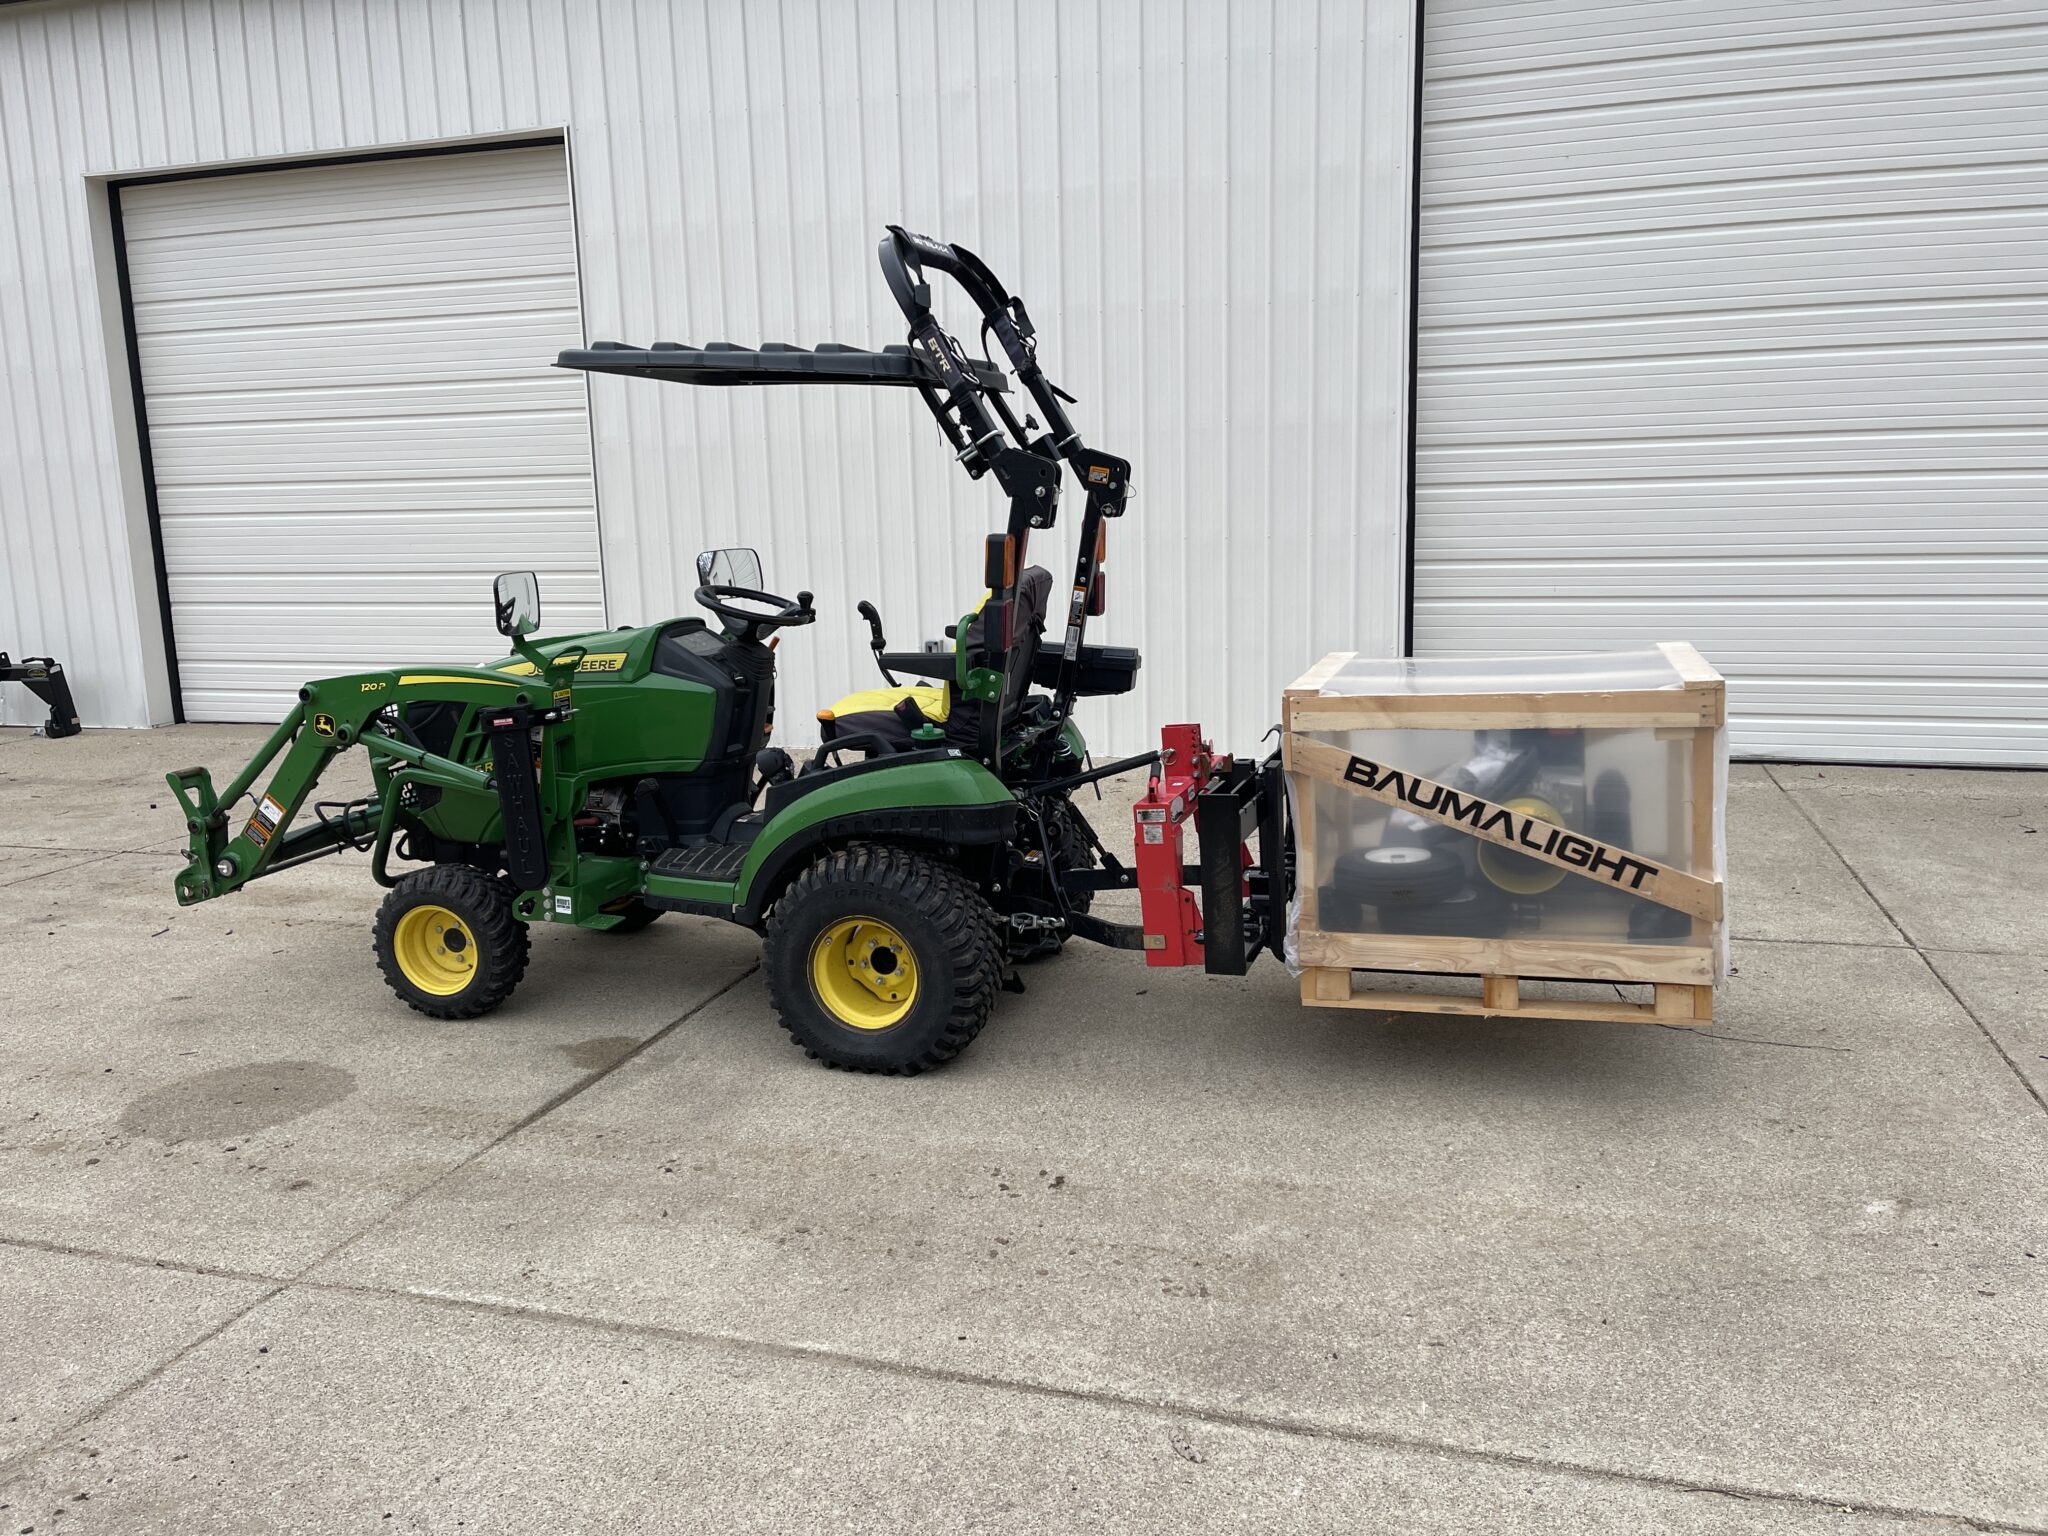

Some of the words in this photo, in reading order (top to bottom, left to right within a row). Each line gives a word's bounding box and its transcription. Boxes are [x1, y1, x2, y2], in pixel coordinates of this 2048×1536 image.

[928, 337, 951, 373] BTR
[504, 733, 534, 874] SAWHAUL
[1343, 755, 1658, 889] BAUMALIGHT
